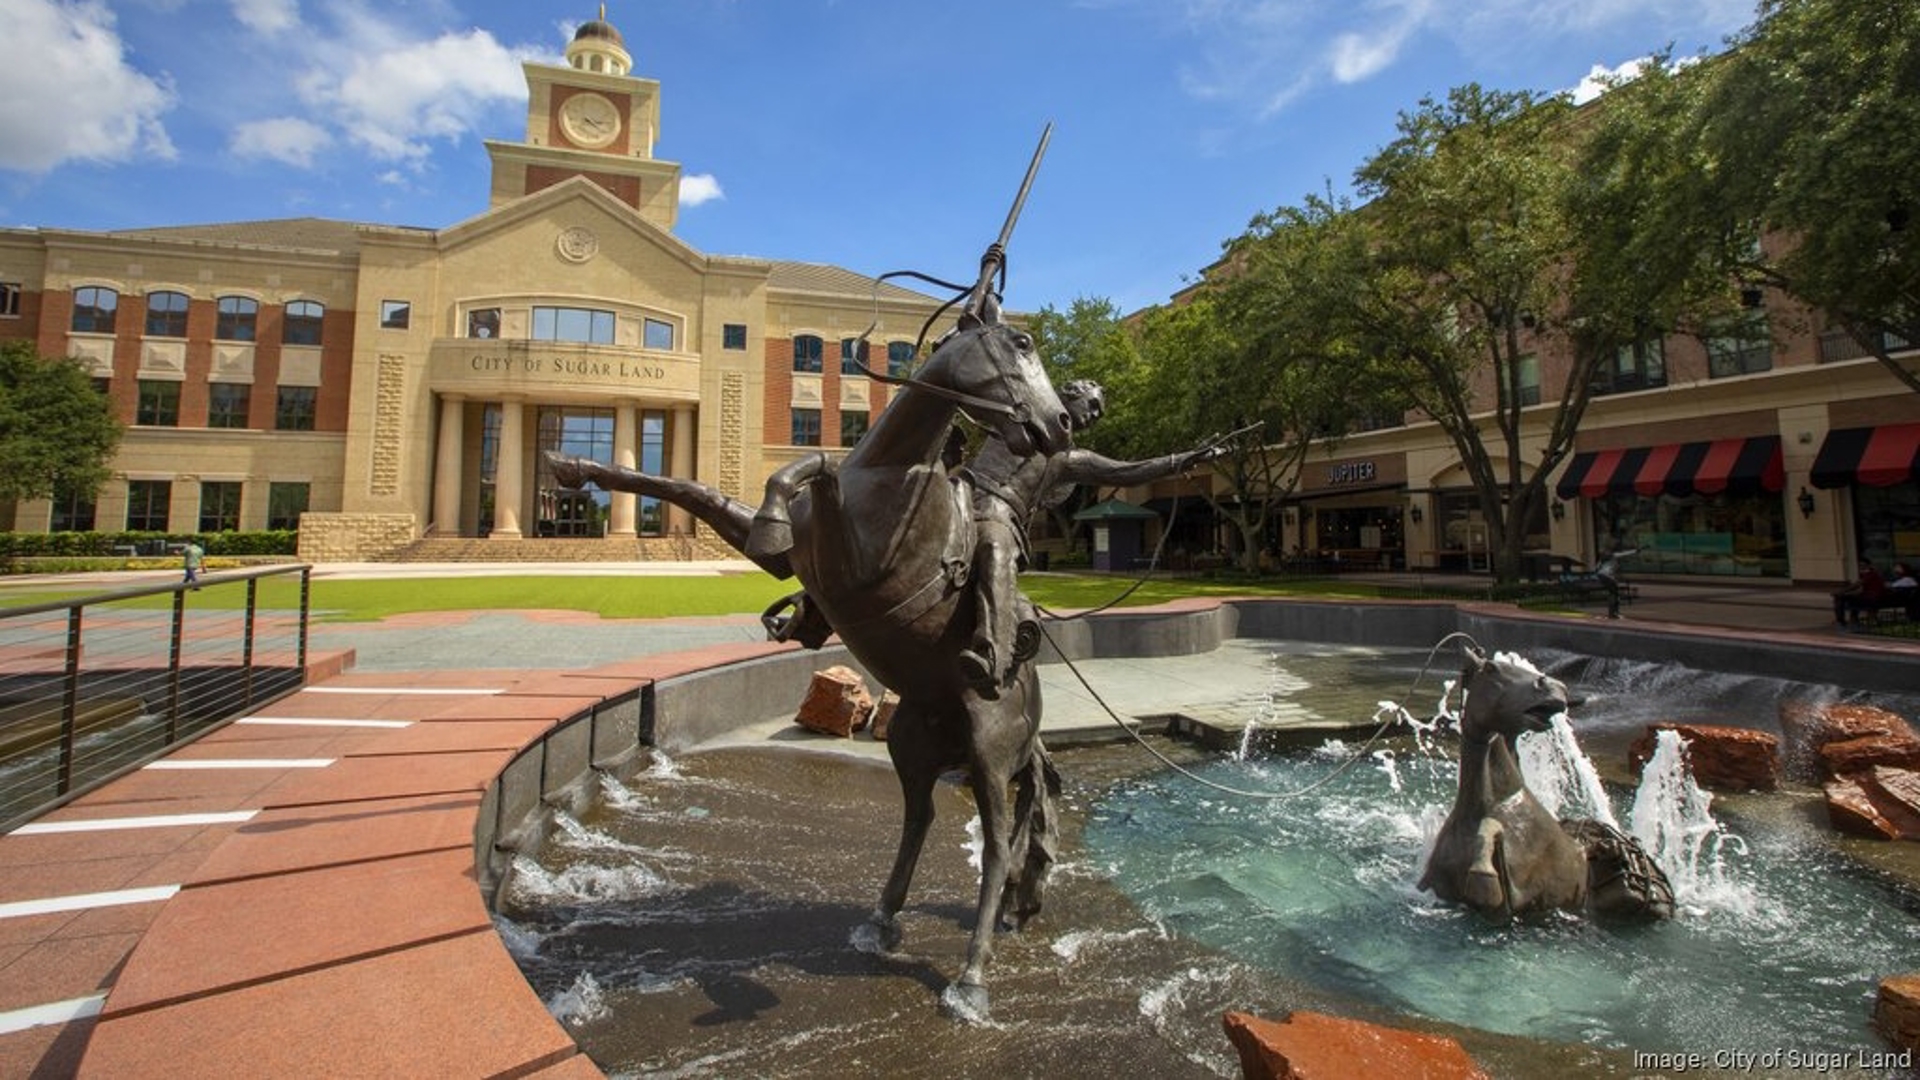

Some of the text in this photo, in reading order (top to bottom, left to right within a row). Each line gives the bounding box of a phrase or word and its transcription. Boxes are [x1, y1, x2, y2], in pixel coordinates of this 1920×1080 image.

[472, 356, 513, 371] CITY
[554, 358, 611, 376] SUGAR
[619, 362, 665, 380] LAND
[1328, 462, 1374, 483] JUPITER
